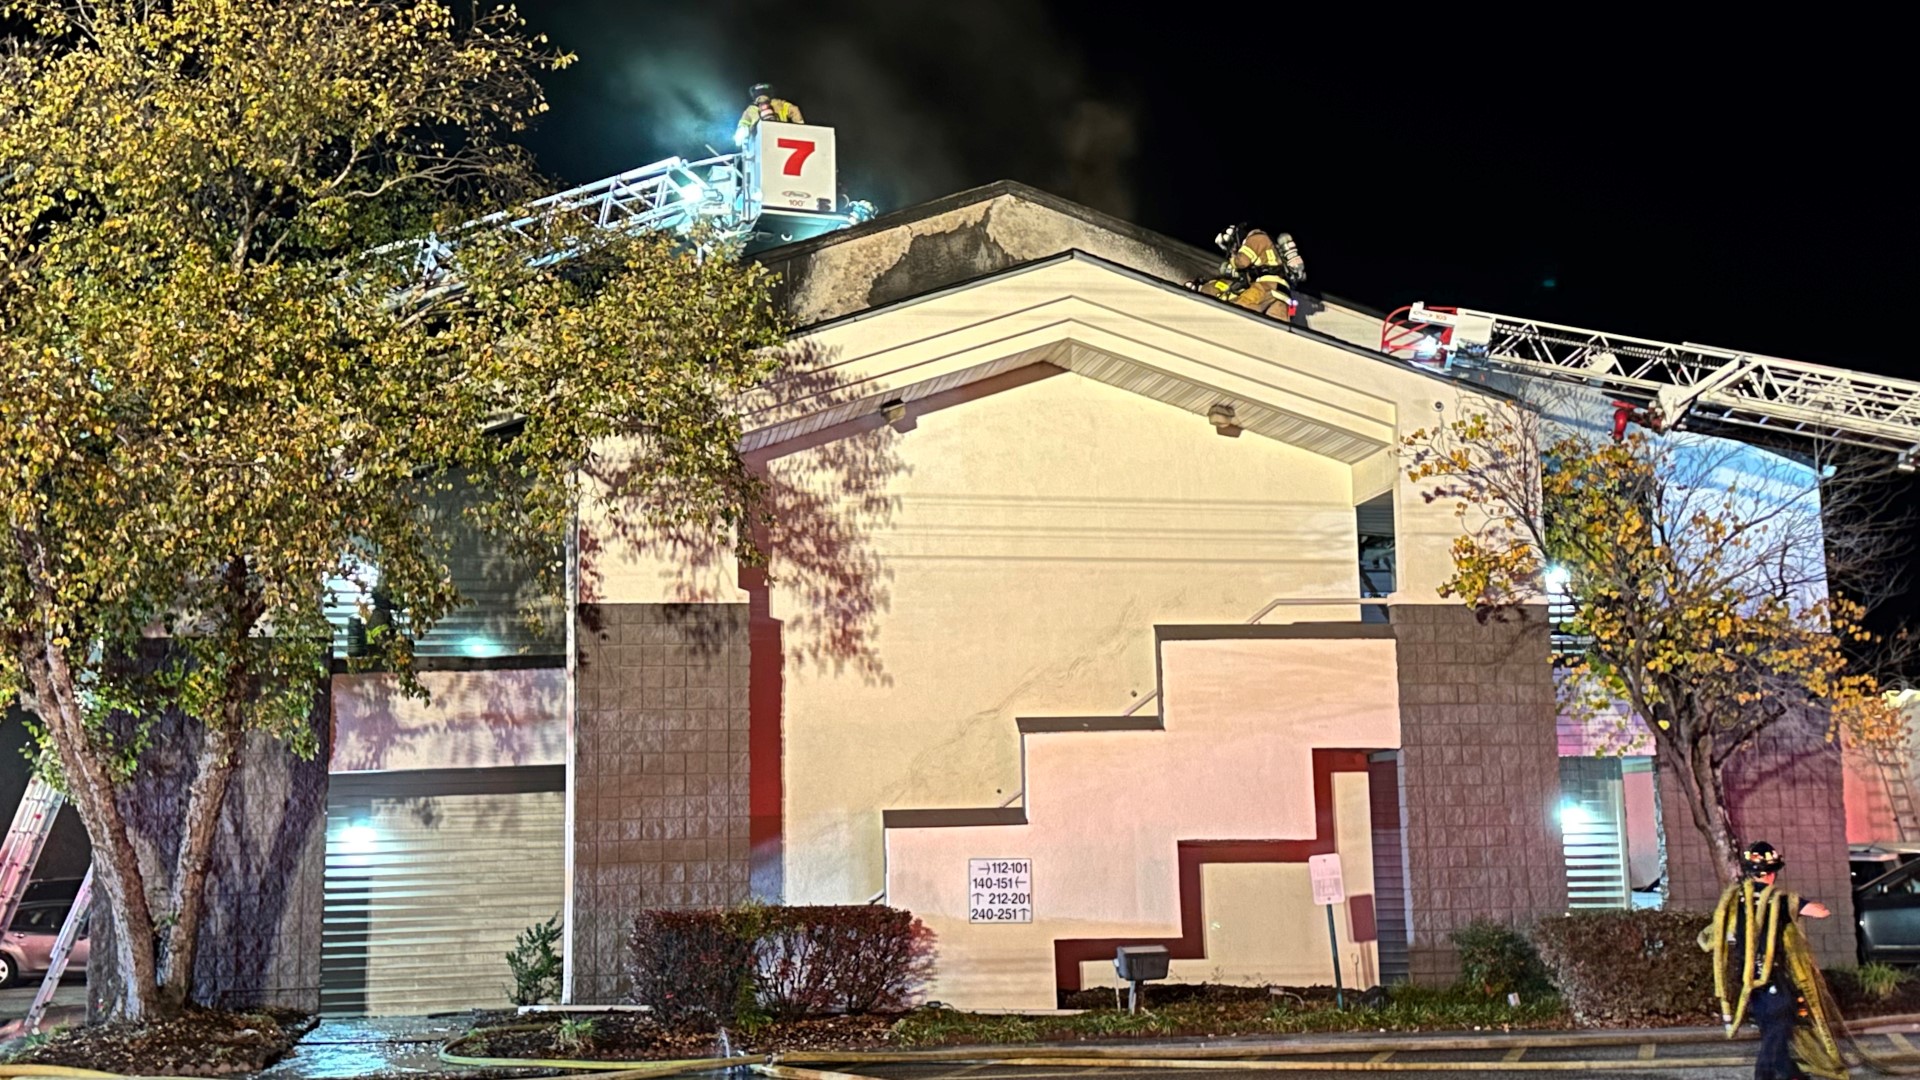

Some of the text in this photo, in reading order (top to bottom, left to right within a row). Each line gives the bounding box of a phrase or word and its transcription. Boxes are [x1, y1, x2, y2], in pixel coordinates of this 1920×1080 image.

[777, 138, 815, 176] 7
[992, 862, 1028, 874] 112-101
[972, 877, 1013, 889] 140-151
[988, 893, 1030, 905] 212-201
[971, 908, 1017, 920] 240-251
